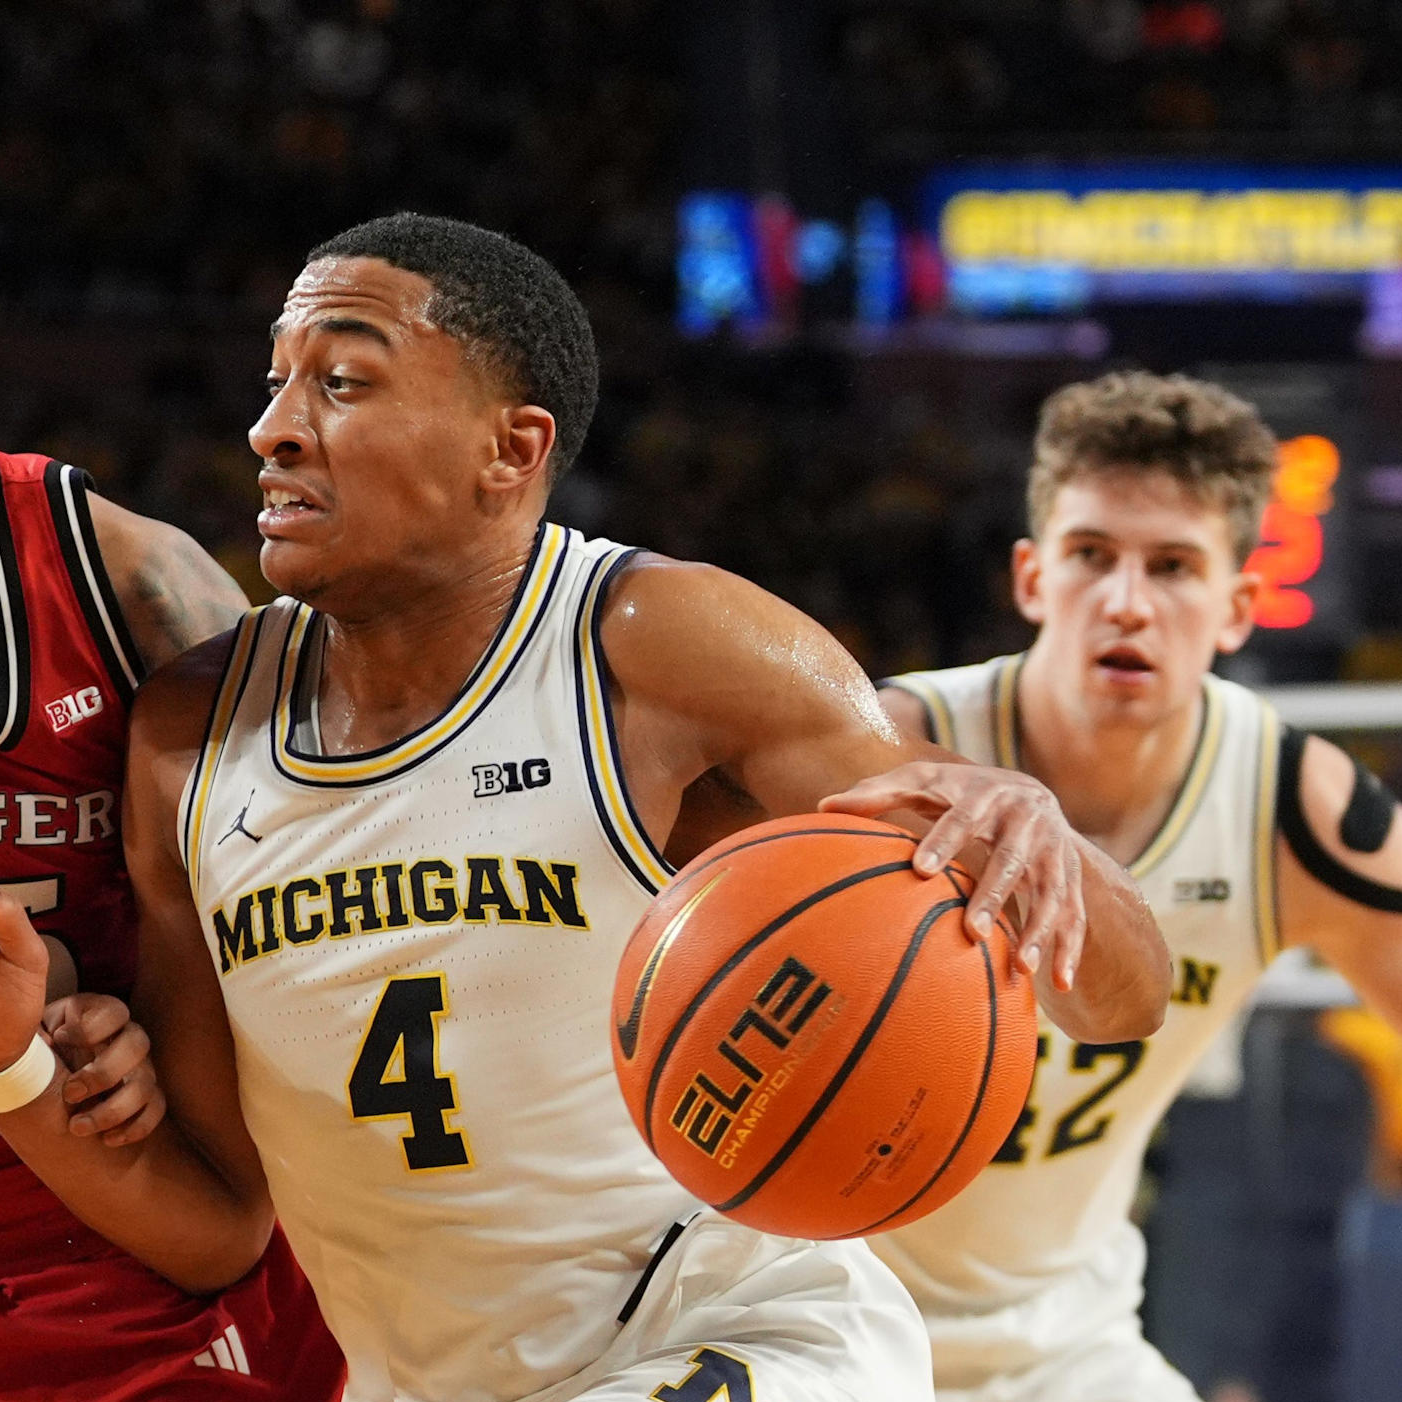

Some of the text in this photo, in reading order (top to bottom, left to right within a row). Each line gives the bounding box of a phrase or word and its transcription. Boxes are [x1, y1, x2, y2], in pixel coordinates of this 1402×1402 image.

[211, 856, 591, 976] MICHIGAN
[348, 970, 473, 1174] 4
[668, 955, 834, 1160] ELITE
[718, 996, 848, 1171] CHAMPION
